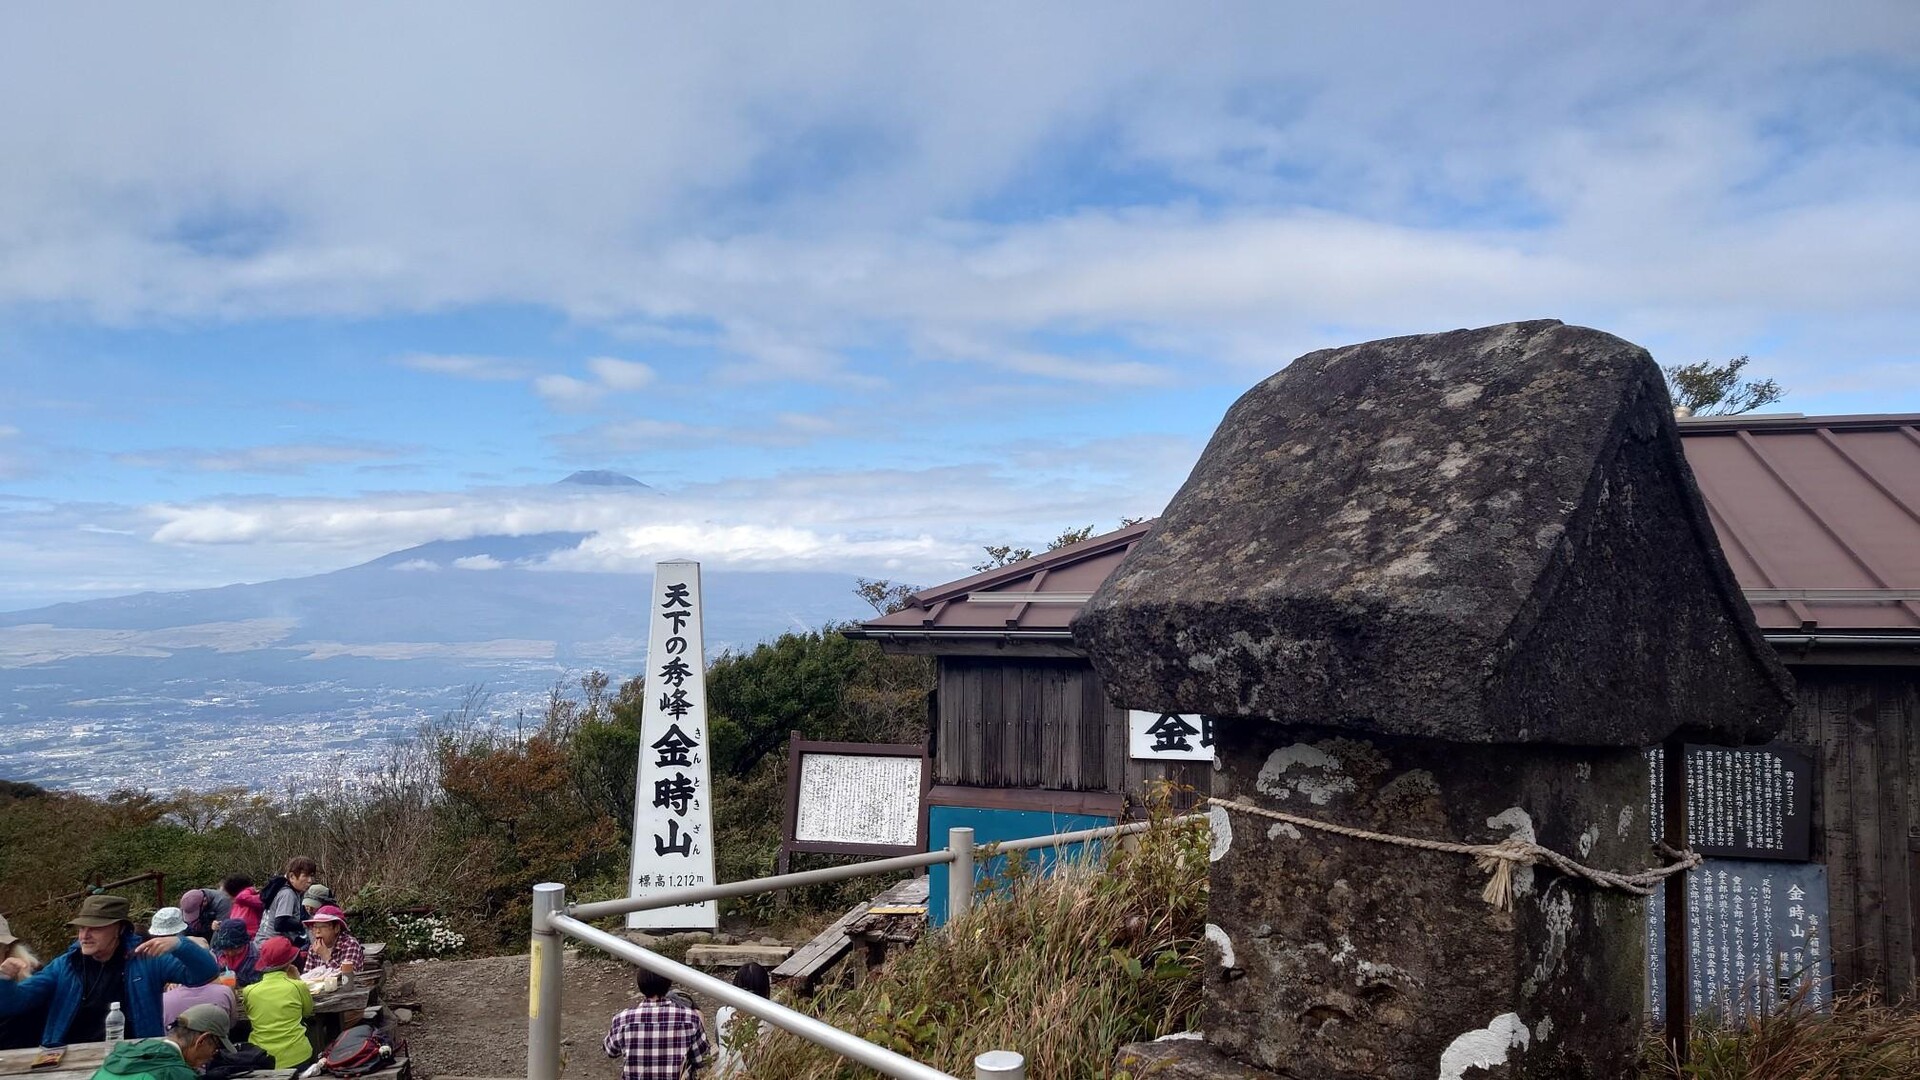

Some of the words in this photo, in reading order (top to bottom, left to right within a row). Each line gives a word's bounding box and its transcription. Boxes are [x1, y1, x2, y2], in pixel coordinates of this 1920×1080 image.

[659, 583, 694, 720] 天下の秀峰
[652, 724, 698, 857] 金時山
[1787, 884, 1806, 938] 金時山
